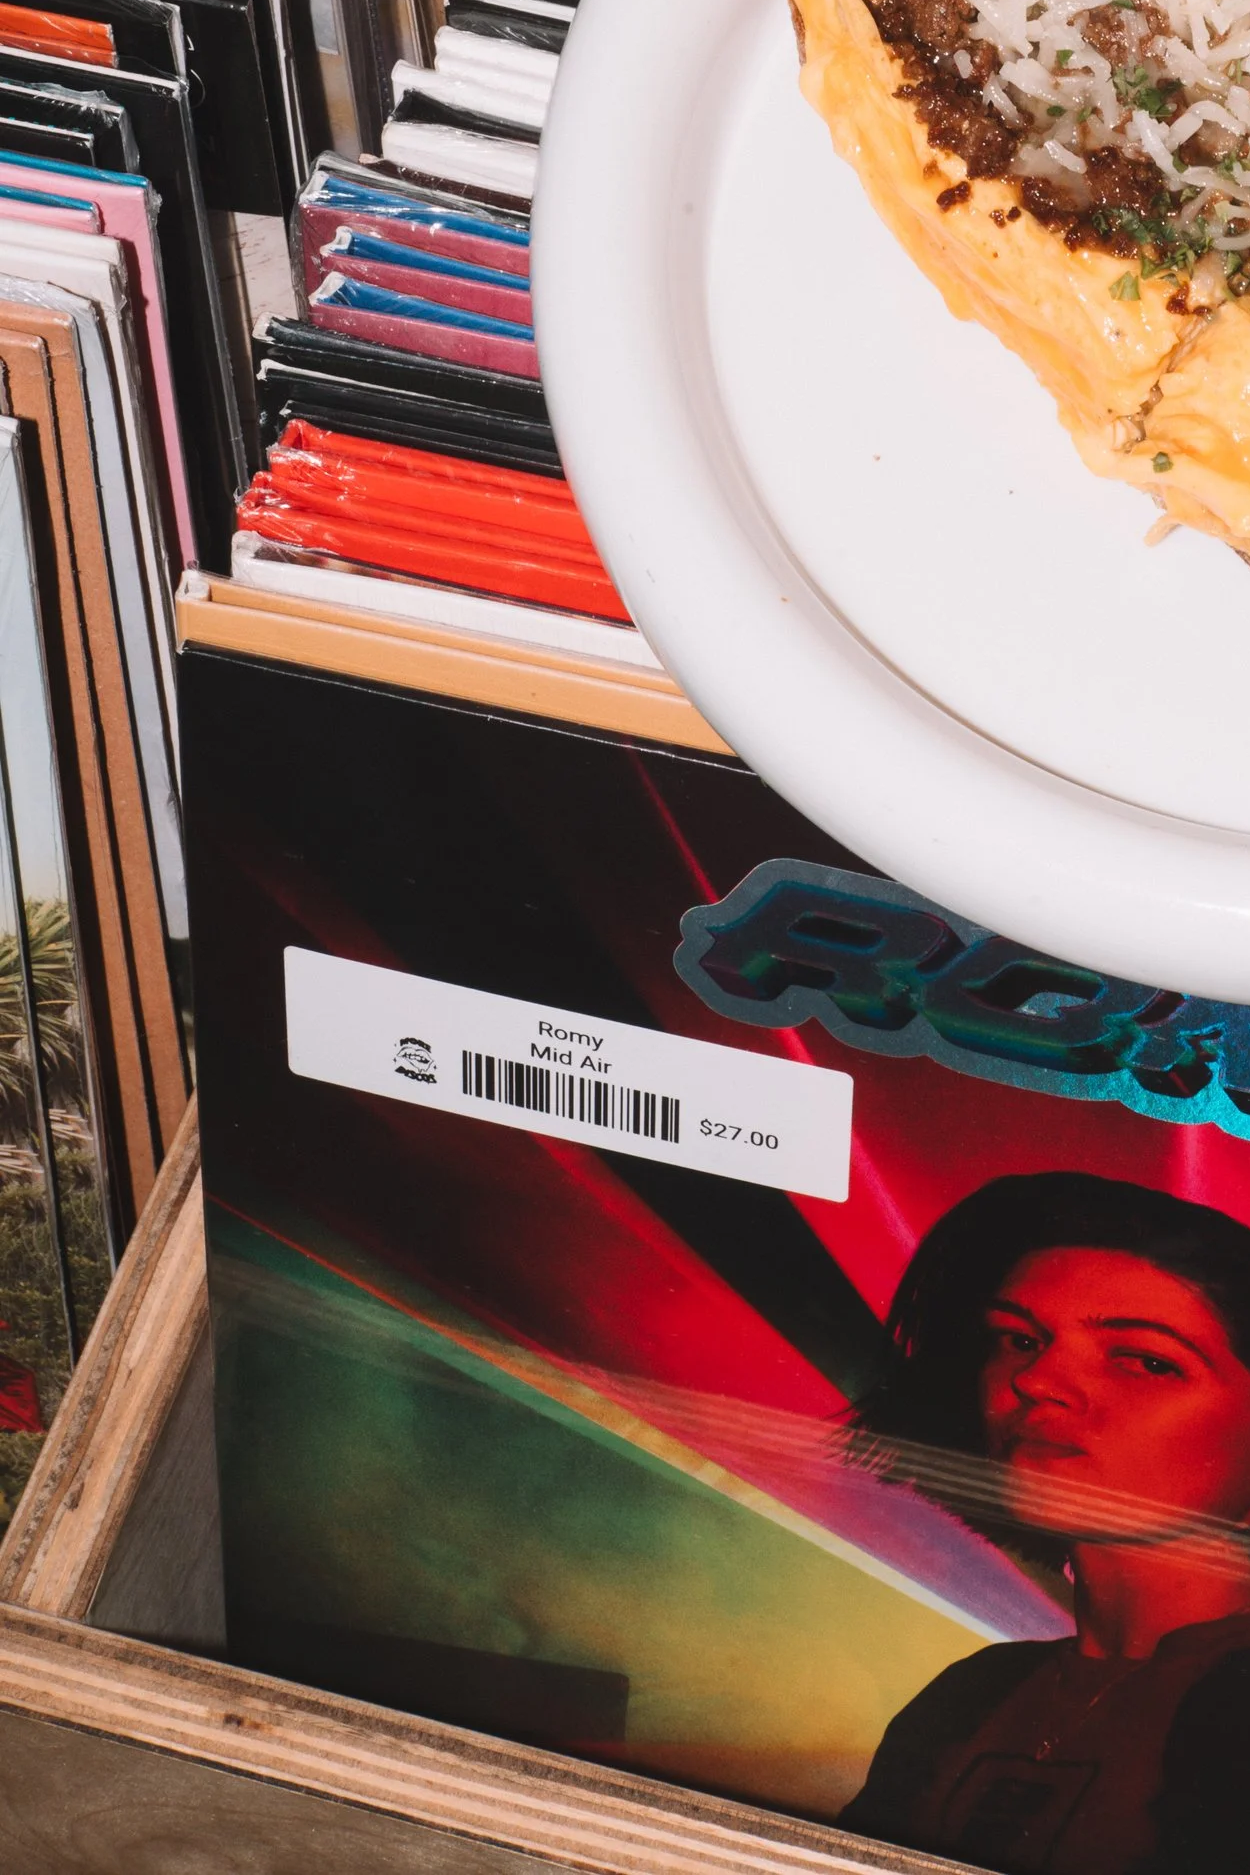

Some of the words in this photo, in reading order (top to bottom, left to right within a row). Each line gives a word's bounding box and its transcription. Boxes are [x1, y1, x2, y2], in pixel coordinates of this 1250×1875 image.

[538, 1020, 604, 1051] Romy
[530, 1042, 573, 1067] Mid
[579, 1054, 613, 1074] Air
[699, 1118, 779, 1150] $27.00
